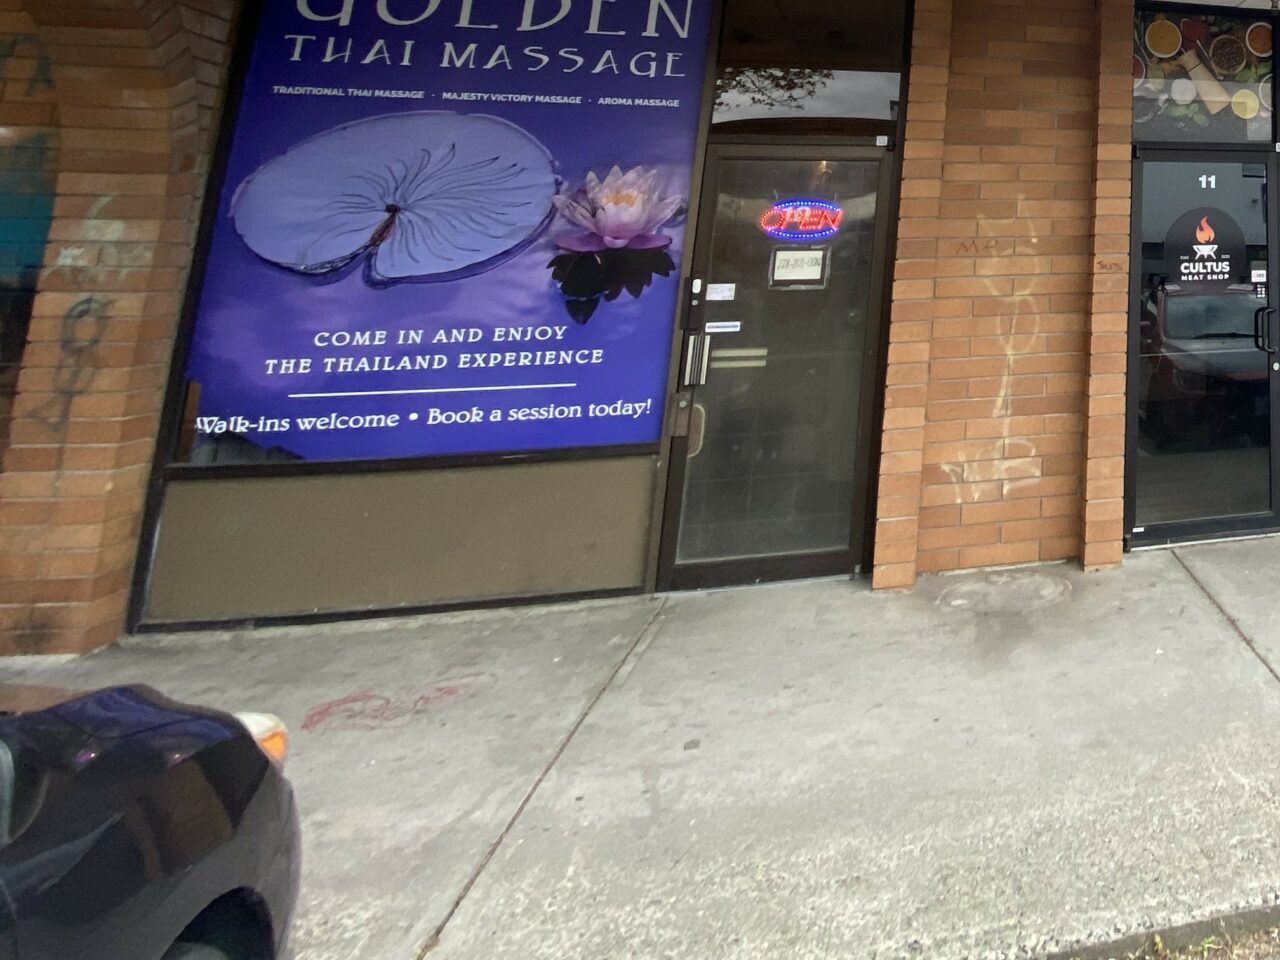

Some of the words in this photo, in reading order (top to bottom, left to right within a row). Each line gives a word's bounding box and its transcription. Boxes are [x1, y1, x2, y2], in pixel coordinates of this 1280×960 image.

[284, 34, 414, 66] THAI
[440, 42, 686, 77] MASSAGE
[272, 85, 345, 96] TRADITIONAL
[348, 88, 372, 97] THAI
[374, 89, 425, 99] MASSAGE
[442, 92, 489, 101] MAJESTY
[491, 94, 533, 103] VICTORY
[535, 95, 582, 104] MASSAGE
[598, 97, 633, 106] AROMA
[635, 98, 680, 108] MASSAGE
[1198, 174, 1216, 189] 11
[1180, 261, 1231, 274] CULTUS
[313, 331, 387, 348] COME
[397, 330, 424, 346] IN
[432, 327, 484, 344] AND
[493, 325, 568, 343] ENJOY
[265, 358, 312, 376] THE
[323, 354, 448, 374] THAILAND
[458, 349, 604, 370] EXPERIENCE
[194, 415, 290, 434] Walk-ins
[297, 412, 400, 431] welcome
[427, 404, 484, 426] Book
[489, 408, 502, 424] a
[508, 404, 582, 422] session
[588, 399, 652, 421] today!
